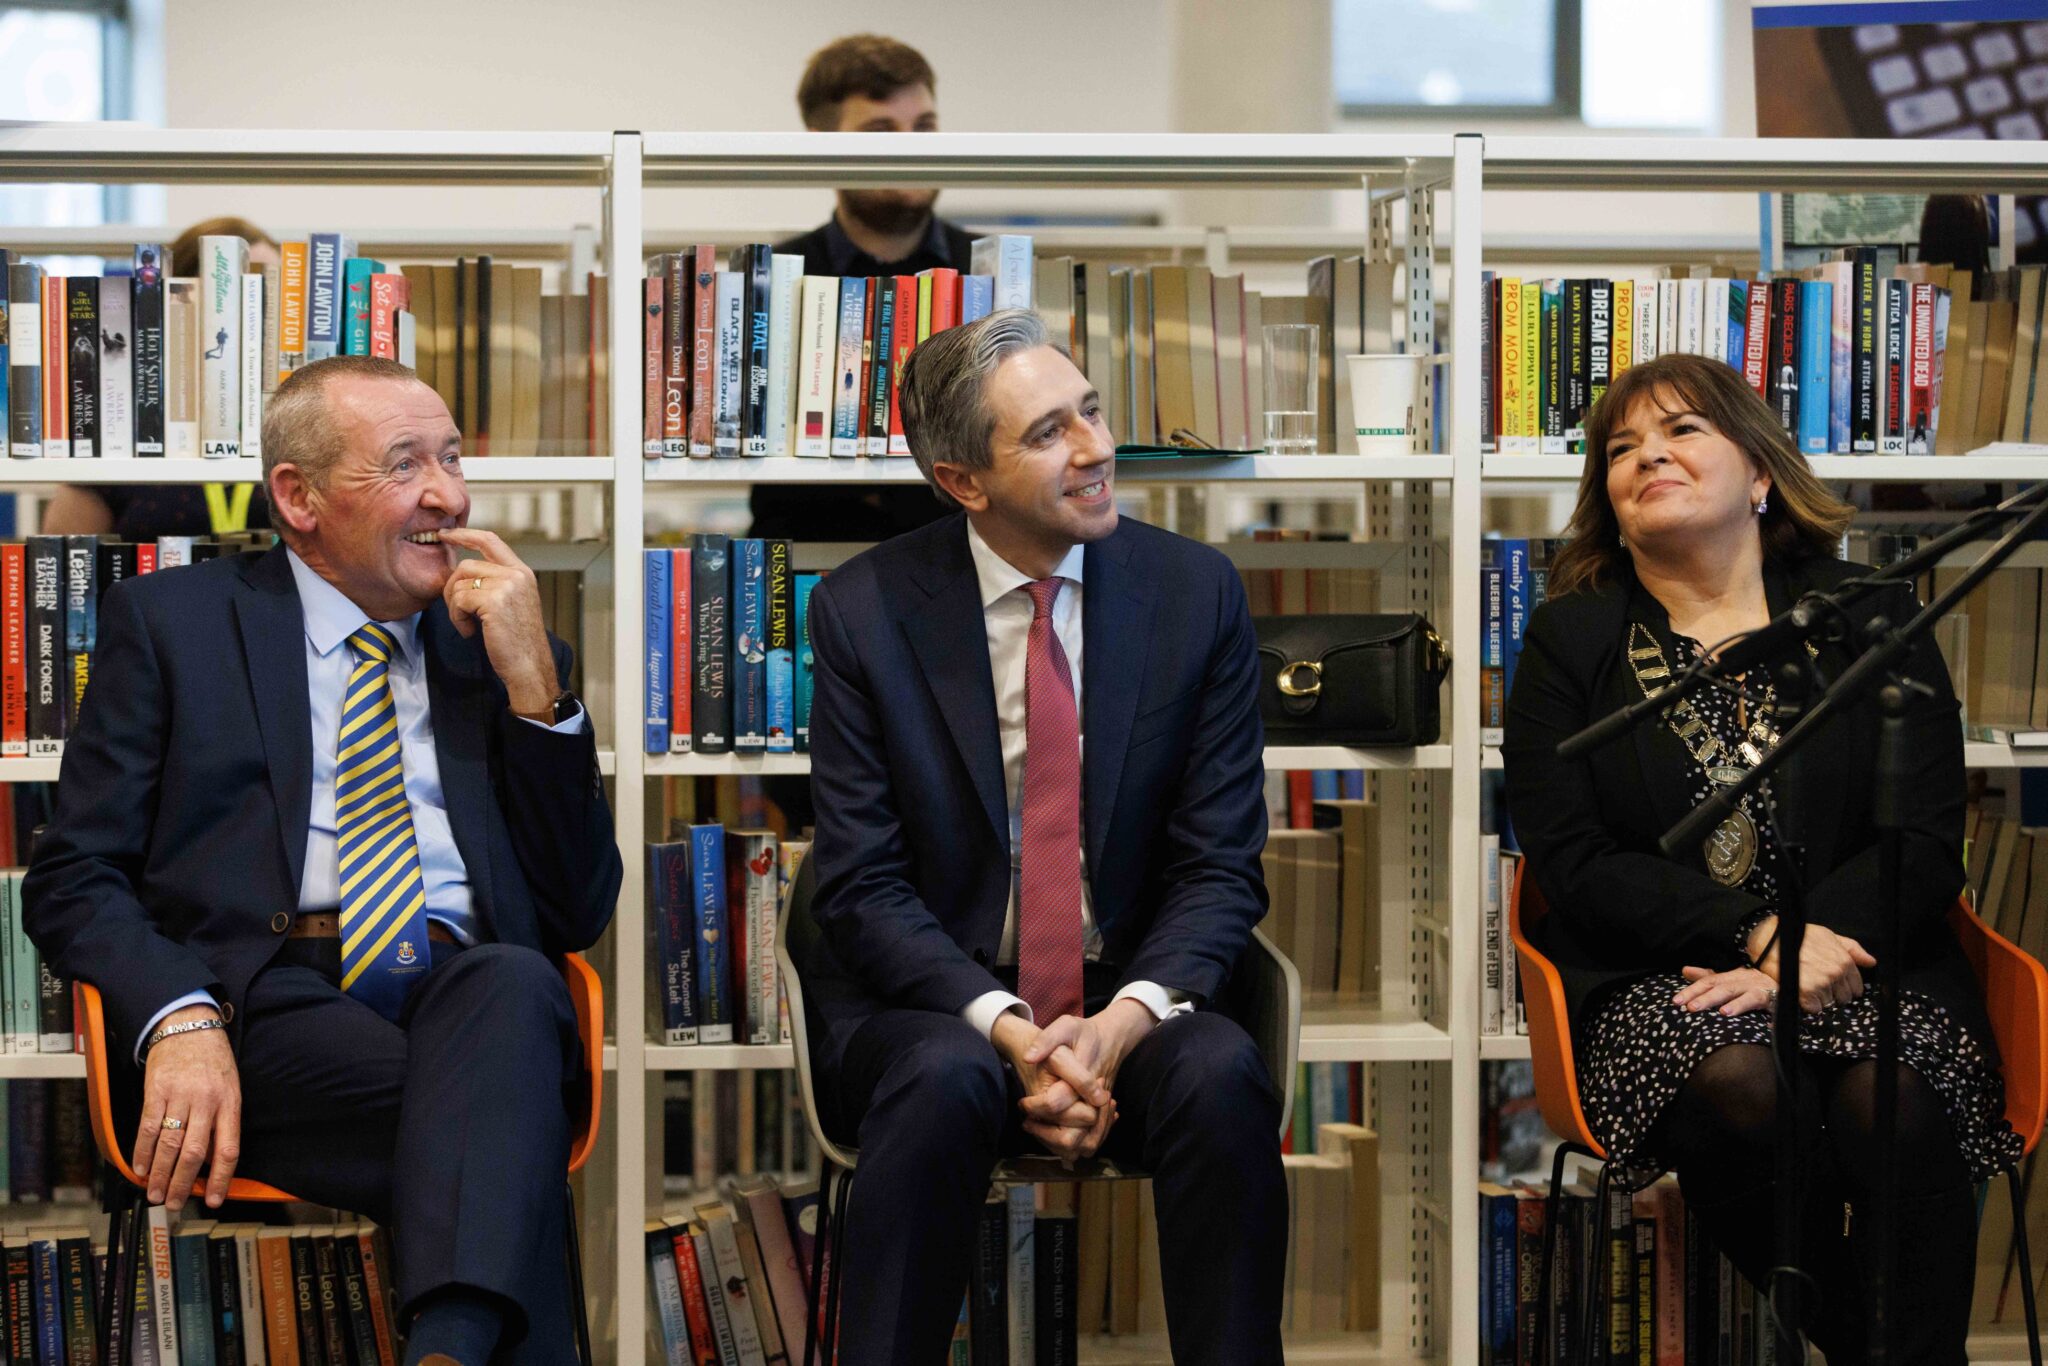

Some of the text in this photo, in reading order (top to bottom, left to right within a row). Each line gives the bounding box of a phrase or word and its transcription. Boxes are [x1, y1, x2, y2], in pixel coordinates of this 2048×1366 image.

[211, 246, 230, 314] Allegations
[284, 252, 302, 345] JOHN LAWTON
[313, 241, 334, 335] JOHN LAWTON
[374, 281, 392, 327] Set on
[843, 293, 854, 324] LIVES
[1916, 284, 1931, 304] THE
[70, 312, 96, 320] STARS
[752, 312, 768, 353] FATAL
[852, 297, 863, 331] THREE
[879, 290, 893, 360] THE FERAL DETECTIVE
[901, 291, 910, 345] CHARLOTTE
[1506, 283, 1518, 376] PROM MOM
[1527, 303, 1535, 336] LAURA
[1572, 286, 1581, 375] LADY IN THE LAKE
[1591, 289, 1608, 381] DREAM GIRL
[1617, 288, 1629, 332] PROM
[1642, 303, 1650, 355] THREE-BODY
[1747, 285, 1767, 361] THE UNWANTED
[1783, 283, 1795, 364] PARIS REQUIEM
[1862, 308, 1872, 353] MY HOME
[1890, 289, 1900, 360] ATTICA LOCKE
[1915, 304, 1930, 359] UNWANTED
[145, 327, 160, 407] HOLY SISTER
[695, 328, 713, 371] Leon
[729, 297, 740, 383] BLACK WEB
[1527, 339, 1535, 386] LIPPMAN
[666, 345, 686, 432] Donna Leon
[719, 328, 729, 423] JAMES LEONARD
[750, 365, 760, 405] LESCROART
[758, 368, 767, 386] JOHN
[811, 352, 823, 396] Doris Lessing
[874, 365, 887, 426] JONATHAN LETHEM
[1862, 360, 1871, 420] ATTICA LOCKE
[1889, 364, 1900, 430] PLEASANTVILLE
[1914, 360, 1929, 387] DEAD
[74, 379, 84, 440] LAWRENCE
[84, 394, 93, 425] MARK
[106, 378, 116, 437] LAWRENCE
[116, 392, 124, 423] MARK
[205, 443, 240, 455] LAW
[647, 444, 661, 452] LEO
[664, 443, 686, 453] LEO
[750, 442, 766, 452] LES
[1884, 441, 1903, 450] LOC
[8, 555, 19, 665] STEPHEN LEATHER
[35, 557, 47, 608] LEATHER
[46, 556, 57, 610] STEPHEN
[69, 549, 88, 614] Leather
[649, 559, 663, 643] Deborah Levy
[745, 543, 759, 634] Susan LEWIS
[772, 543, 786, 647] SUSAN LEWIS
[1510, 550, 1523, 640] family of liars
[1535, 573, 1545, 595] SHE
[697, 601, 710, 693] Who's Lying Now?
[710, 596, 725, 698] SUSAN LEWIS
[1489, 573, 1500, 666] BLUEBIRD, BLUEBIRD
[40, 624, 52, 705] DARK FORCES
[649, 646, 664, 718] August Blue
[5, 675, 14, 726] RUNNER
[747, 671, 756, 723] home truths
[36, 743, 58, 753] LEA
[700, 832, 715, 925] Susan LEWIS
[748, 893, 760, 1014] have something to tell you
[762, 899, 774, 998] SUSAN LEWIS
[1486, 910, 1499, 990] The END of EDDY
[667, 963, 680, 1004] She Left
[680, 948, 692, 1017] The Moment
[672, 1031, 696, 1042] LEW
[42, 1252, 53, 1322] SINCE WE FELL
[70, 1248, 85, 1329] LIVE BY NIGHT
[153, 1226, 174, 1350] LUSTER RAVEN LEILANI
[297, 1275, 313, 1311] Leon
[321, 1274, 336, 1310] Leon
[347, 1274, 364, 1311] Leon
[1054, 1225, 1064, 1318] PRINCESS BLOOD
[1521, 1252, 1532, 1302] OPINION
[1638, 1258, 1650, 1274] THE
[19, 1279, 32, 1359] DENNIS LEHANE
[273, 1258, 289, 1345] WIDE WORLD
[138, 1317, 151, 1346] SMALL
